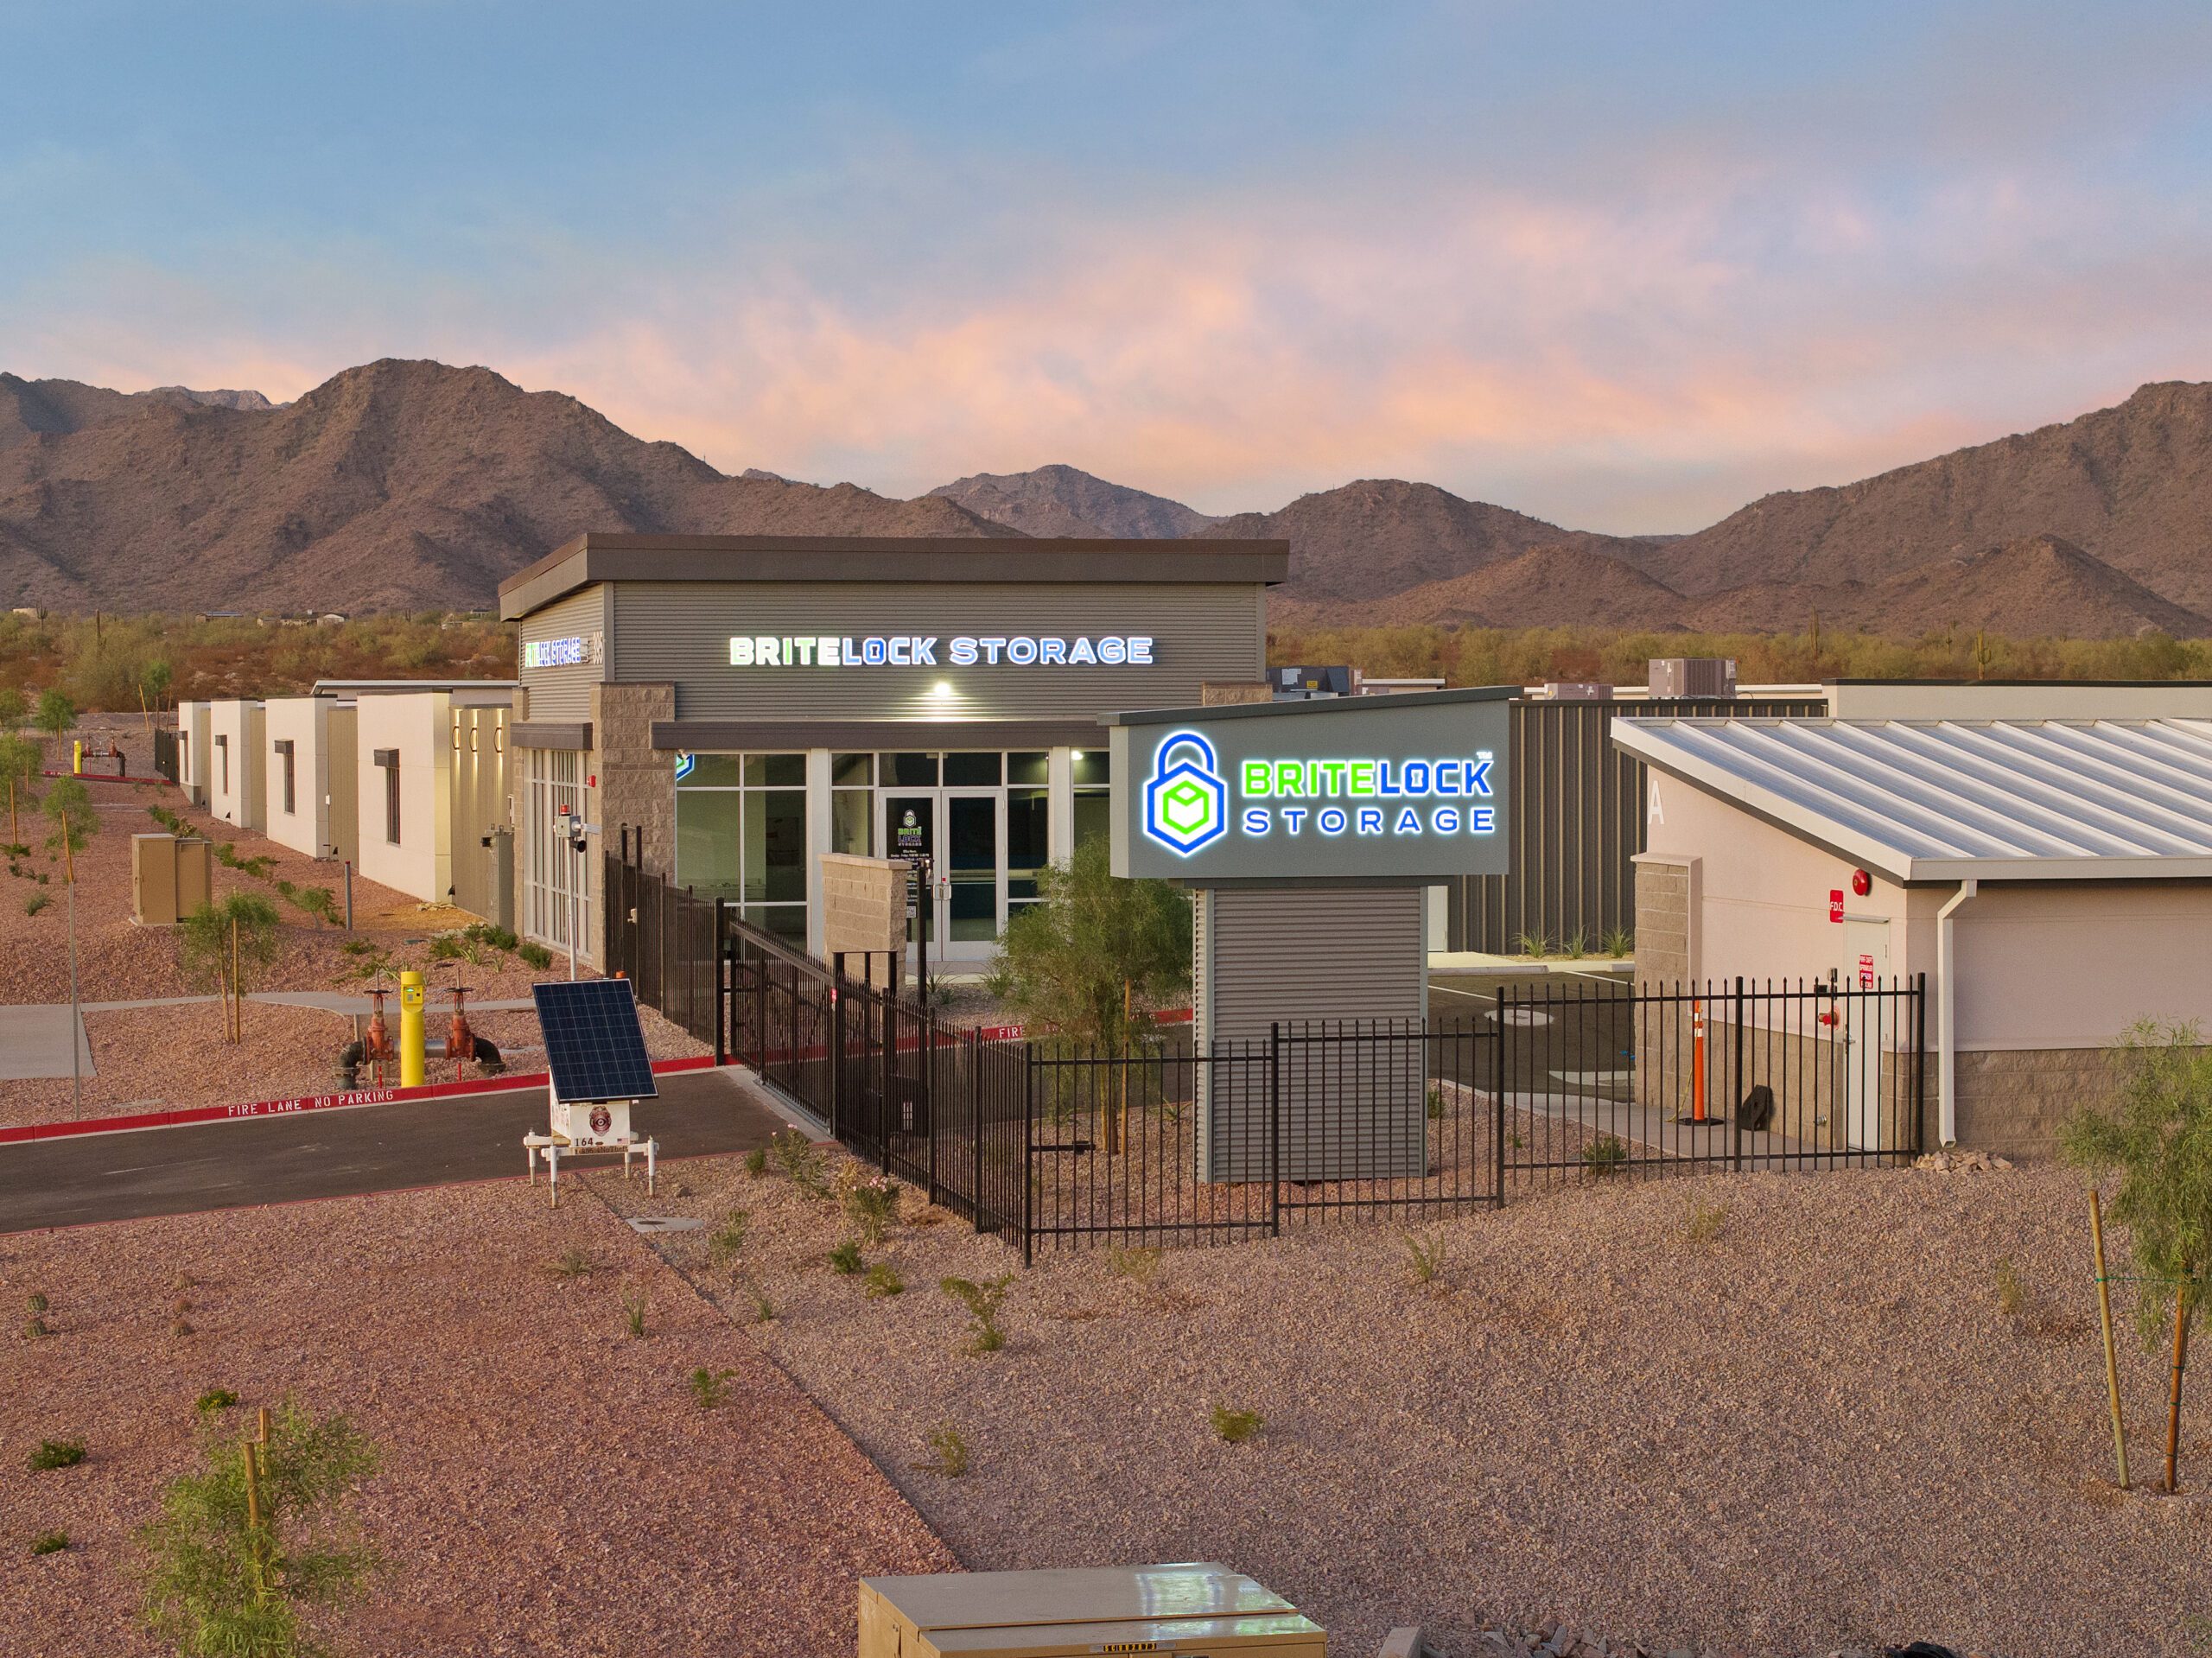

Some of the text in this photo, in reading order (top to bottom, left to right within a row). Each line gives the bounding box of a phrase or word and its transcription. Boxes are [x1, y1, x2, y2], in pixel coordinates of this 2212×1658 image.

[729, 636, 1154, 665] BRITELOCK STORAGE
[1243, 760, 1494, 797] BRITELOCK
[1648, 780, 1664, 824] A
[1243, 806, 1494, 835] STORAGE
[228, 1090, 393, 1116] FIRE LANE NO PARKING
[575, 1137, 593, 1147] 164
